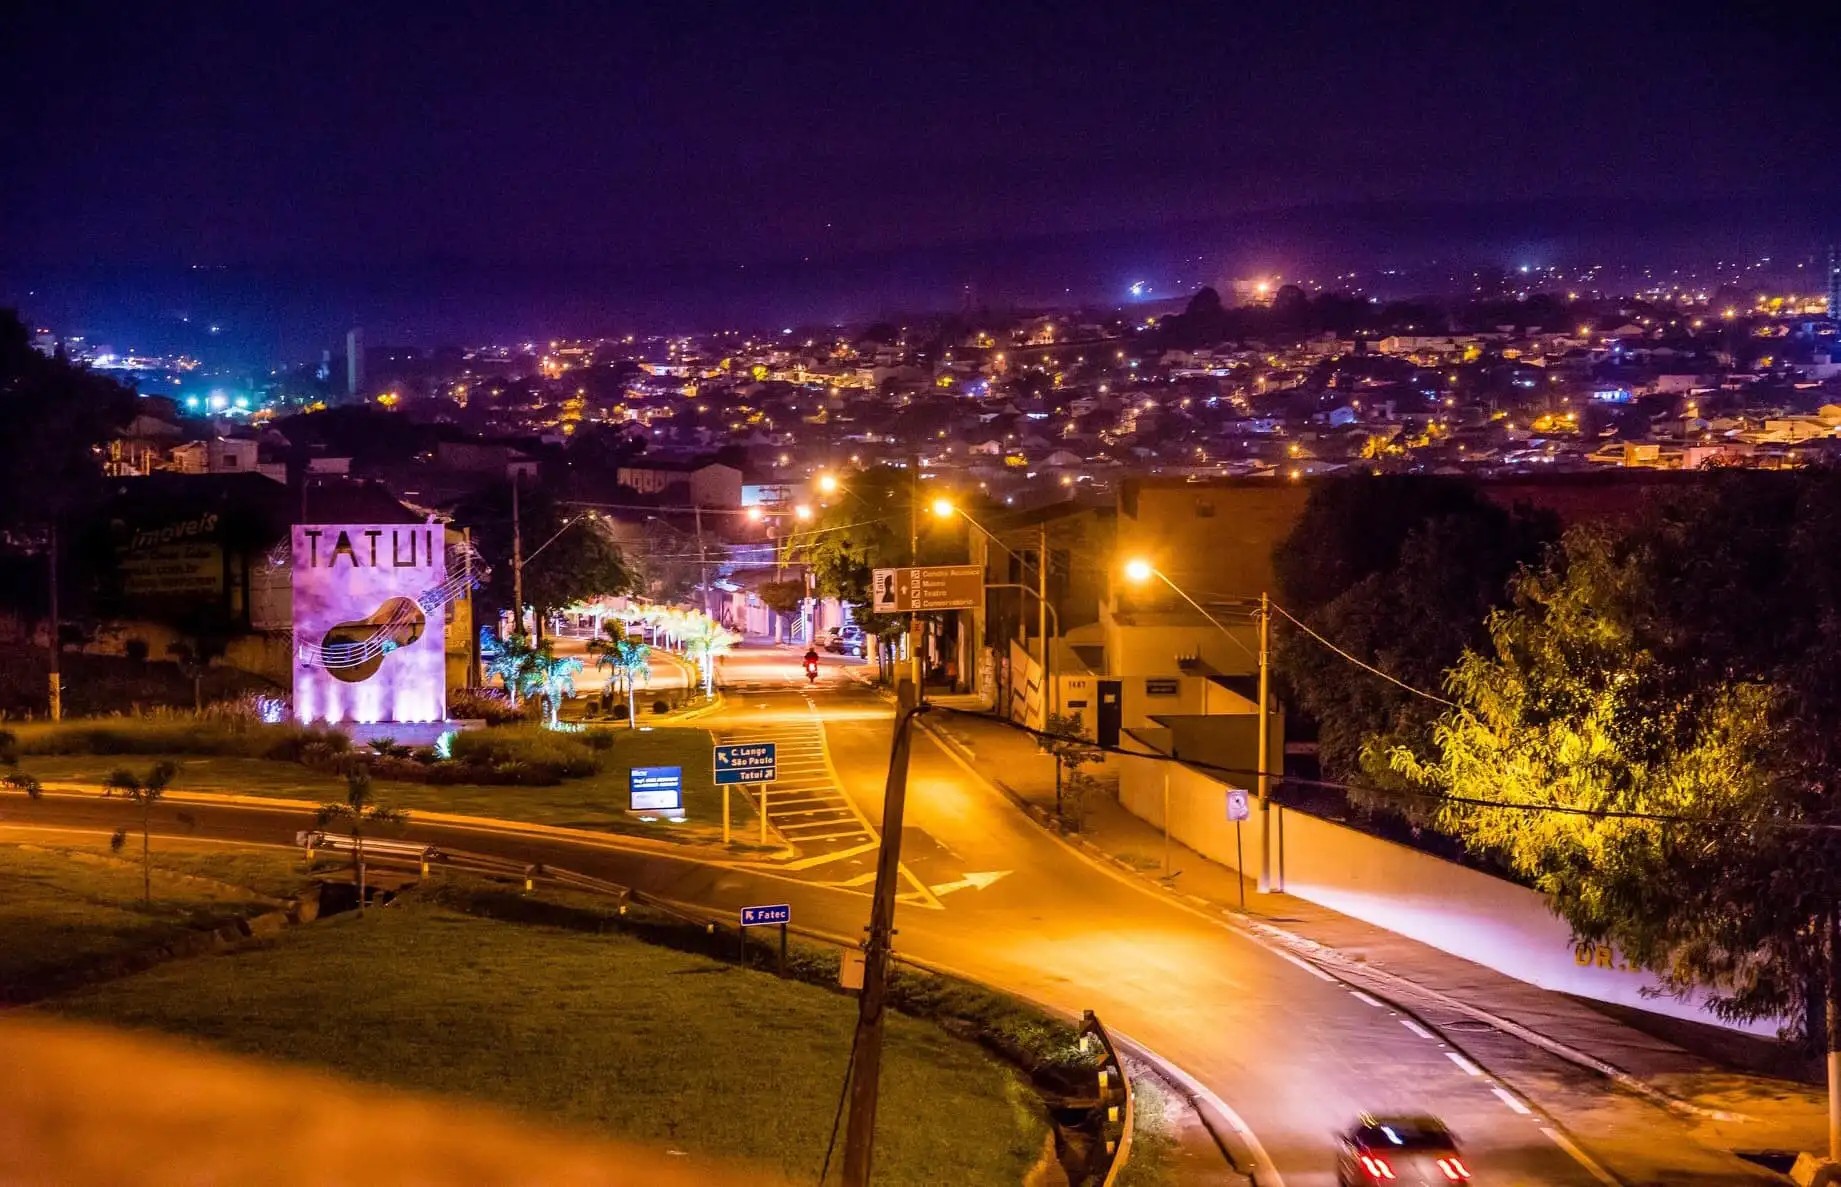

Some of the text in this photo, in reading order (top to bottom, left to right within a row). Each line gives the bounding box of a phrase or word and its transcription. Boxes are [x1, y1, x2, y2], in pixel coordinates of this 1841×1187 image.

[741, 747, 767, 757] Lange
[731, 756, 773, 766] São Paulo
[758, 910, 786, 920] Fatec
